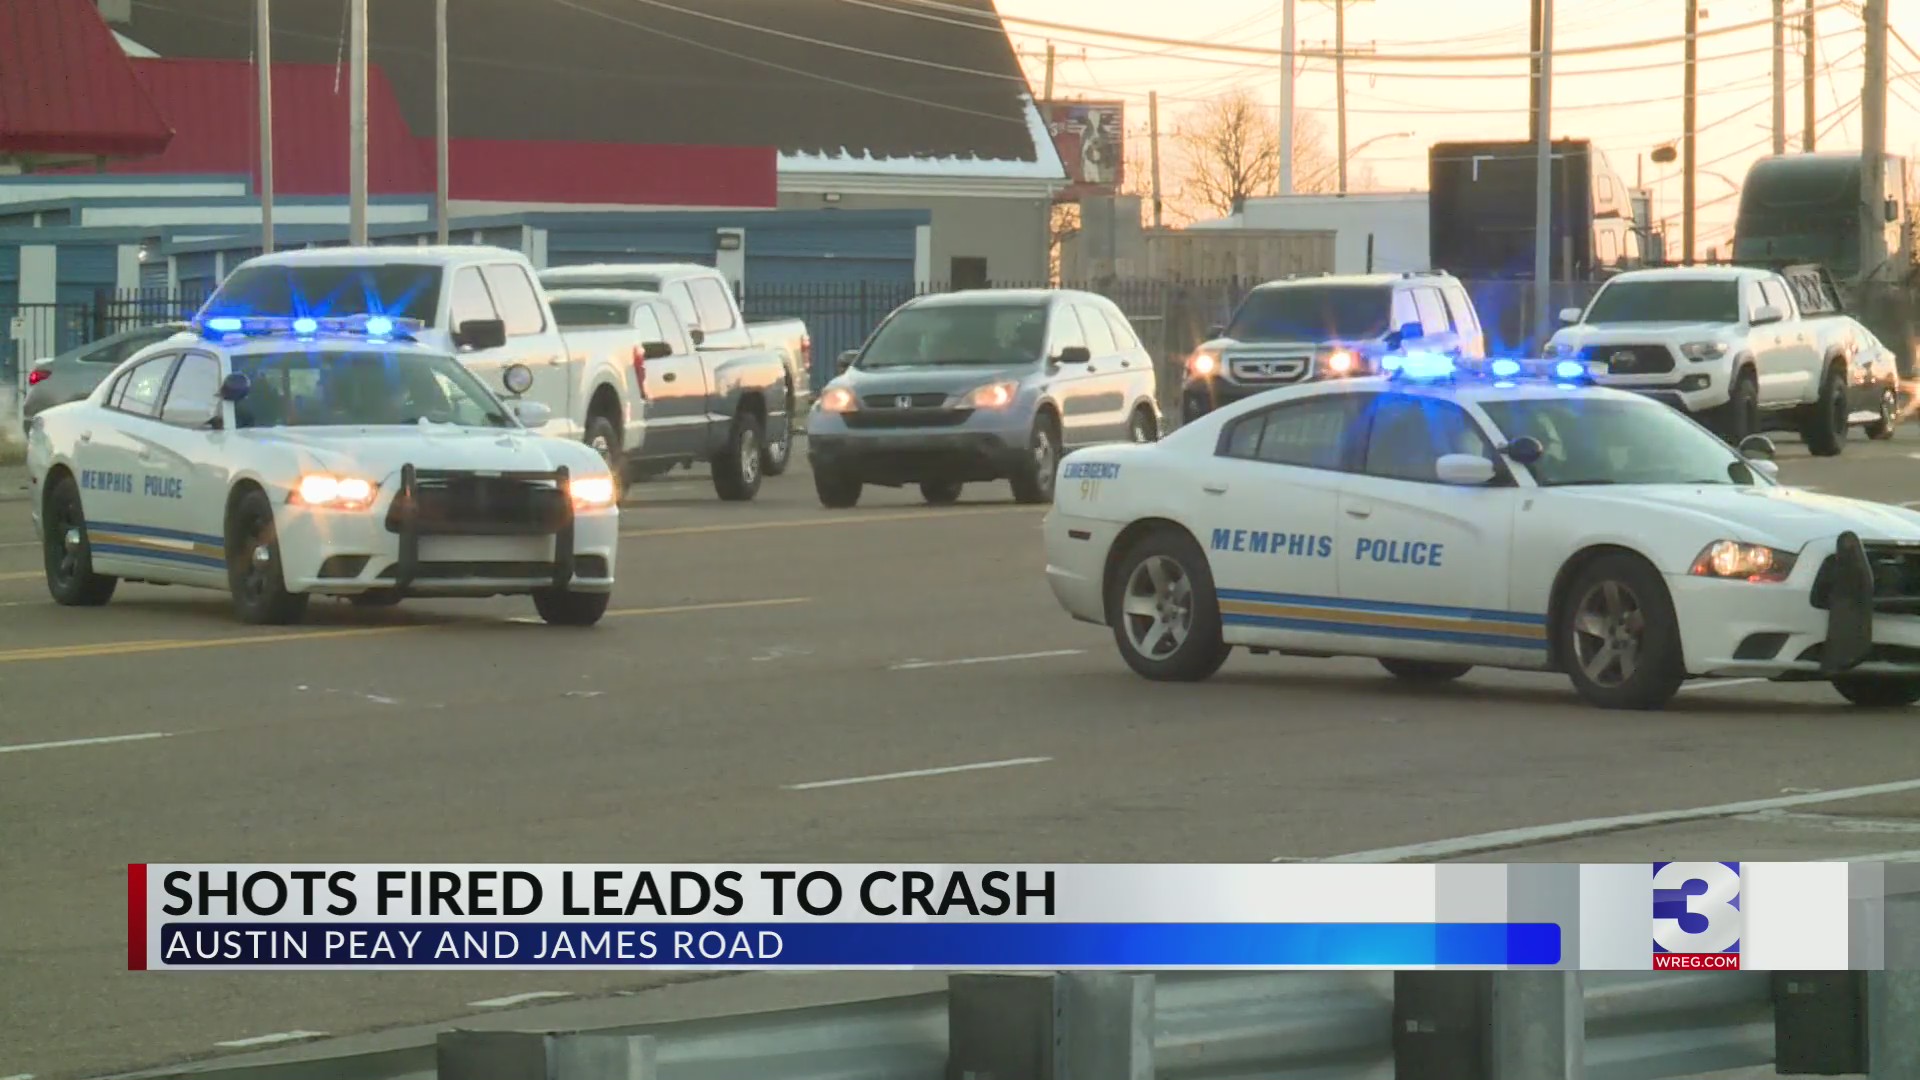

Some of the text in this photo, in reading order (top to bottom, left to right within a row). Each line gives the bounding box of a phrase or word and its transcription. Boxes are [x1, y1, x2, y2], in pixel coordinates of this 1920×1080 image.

[81, 469, 183, 499] MEMPHIS POLICE
[1064, 462, 1121, 479] EMERGENCY
[1210, 528, 1444, 567] MEMPHIS POLICE
